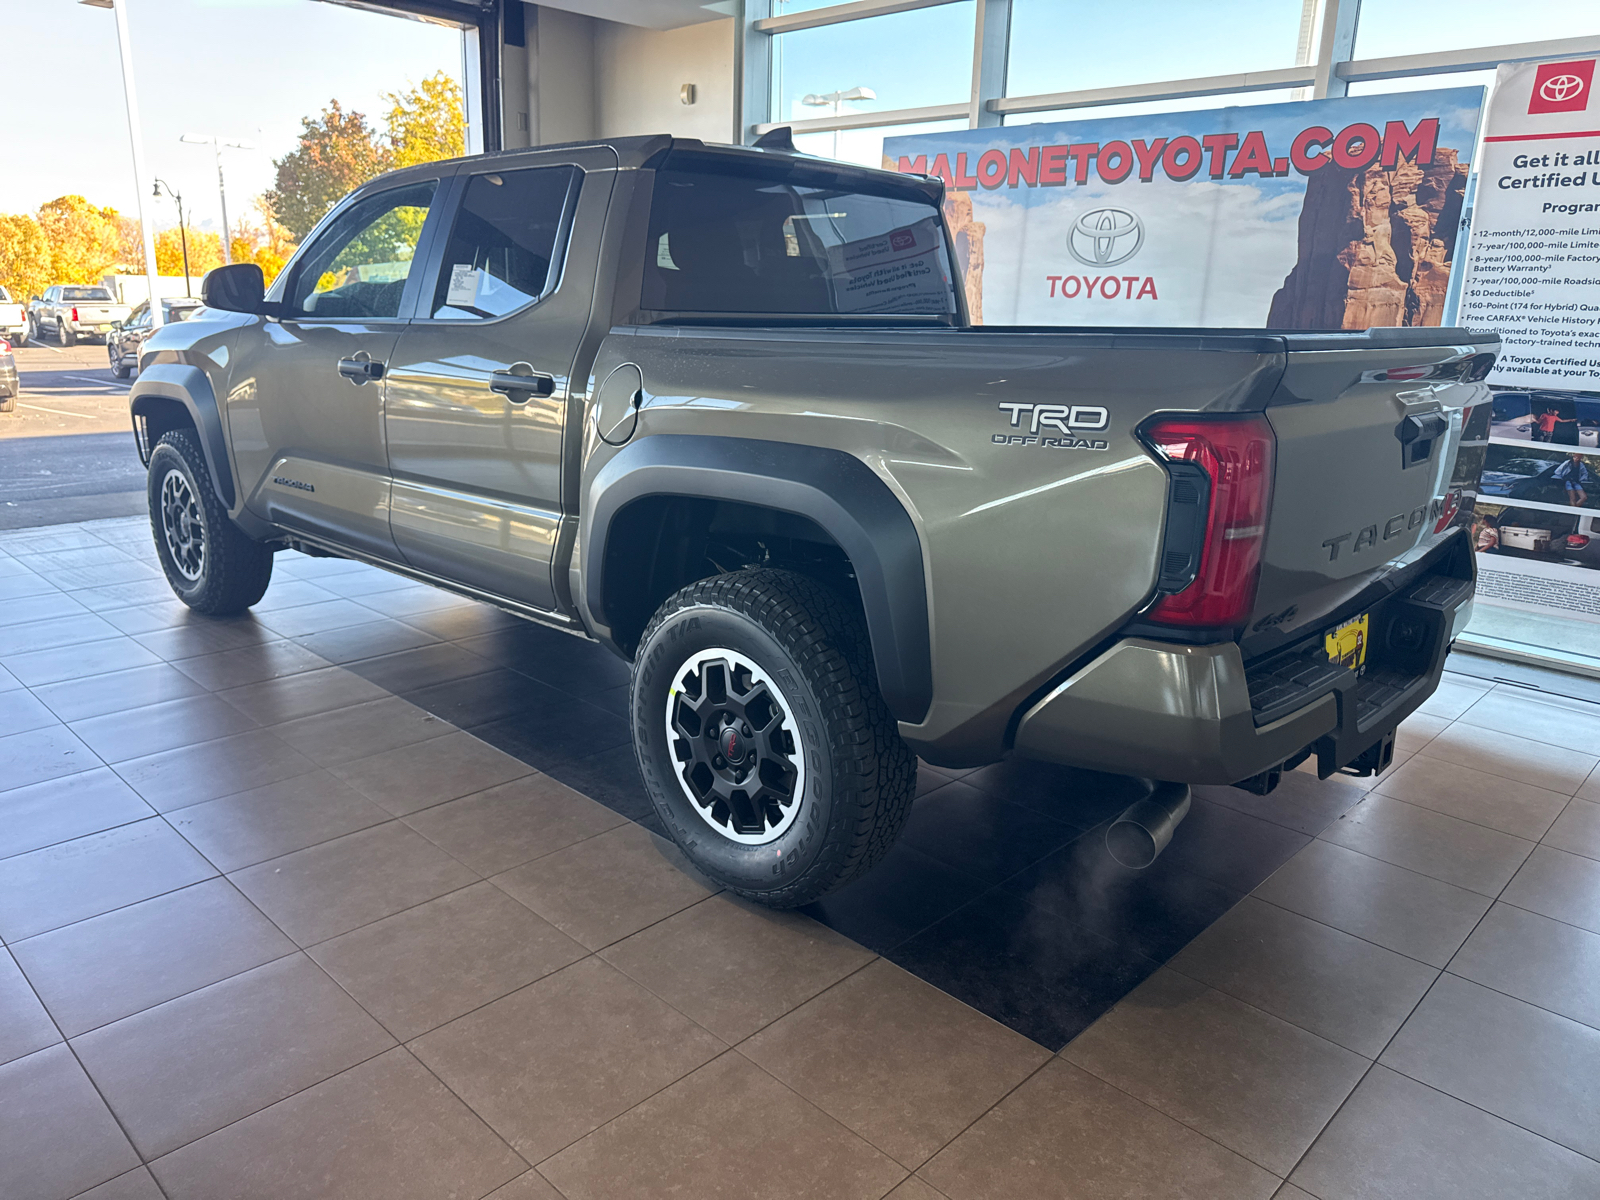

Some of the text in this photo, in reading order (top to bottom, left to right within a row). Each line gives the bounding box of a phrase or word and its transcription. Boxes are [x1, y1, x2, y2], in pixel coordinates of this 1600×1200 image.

[898, 117, 1440, 192] MALONETOYOTA.COM
[1513, 150, 1600, 169] Get it all
[1498, 172, 1587, 189] Certified
[1479, 228, 1579, 238] 12-month/12,000-mile
[1477, 241, 1568, 251] 7-year/100,000-mile
[1475, 254, 1564, 263] 8-year/100,000-mile
[1473, 265, 1505, 273] Battery
[1472, 277, 1561, 286] 7-year/100,000-mile
[1046, 275, 1158, 300] TOYOTA
[1470, 289, 1481, 298] $0
[1510, 302, 1528, 311] (174
[1544, 303, 1578, 312] Hybrid)
[1528, 315, 1560, 324] Vehicle
[1561, 316, 1596, 326] History
[1529, 328, 1538, 336] to
[1505, 337, 1572, 347] factory-trained
[1509, 355, 1541, 365] Toyota
[1543, 357, 1587, 367] Certified
[1491, 364, 1505, 373] nly
[1505, 365, 1550, 375] available
[998, 402, 1111, 437] TRD
[991, 434, 1109, 451] OFF ROAD
[1322, 489, 1462, 562] TACOMA
